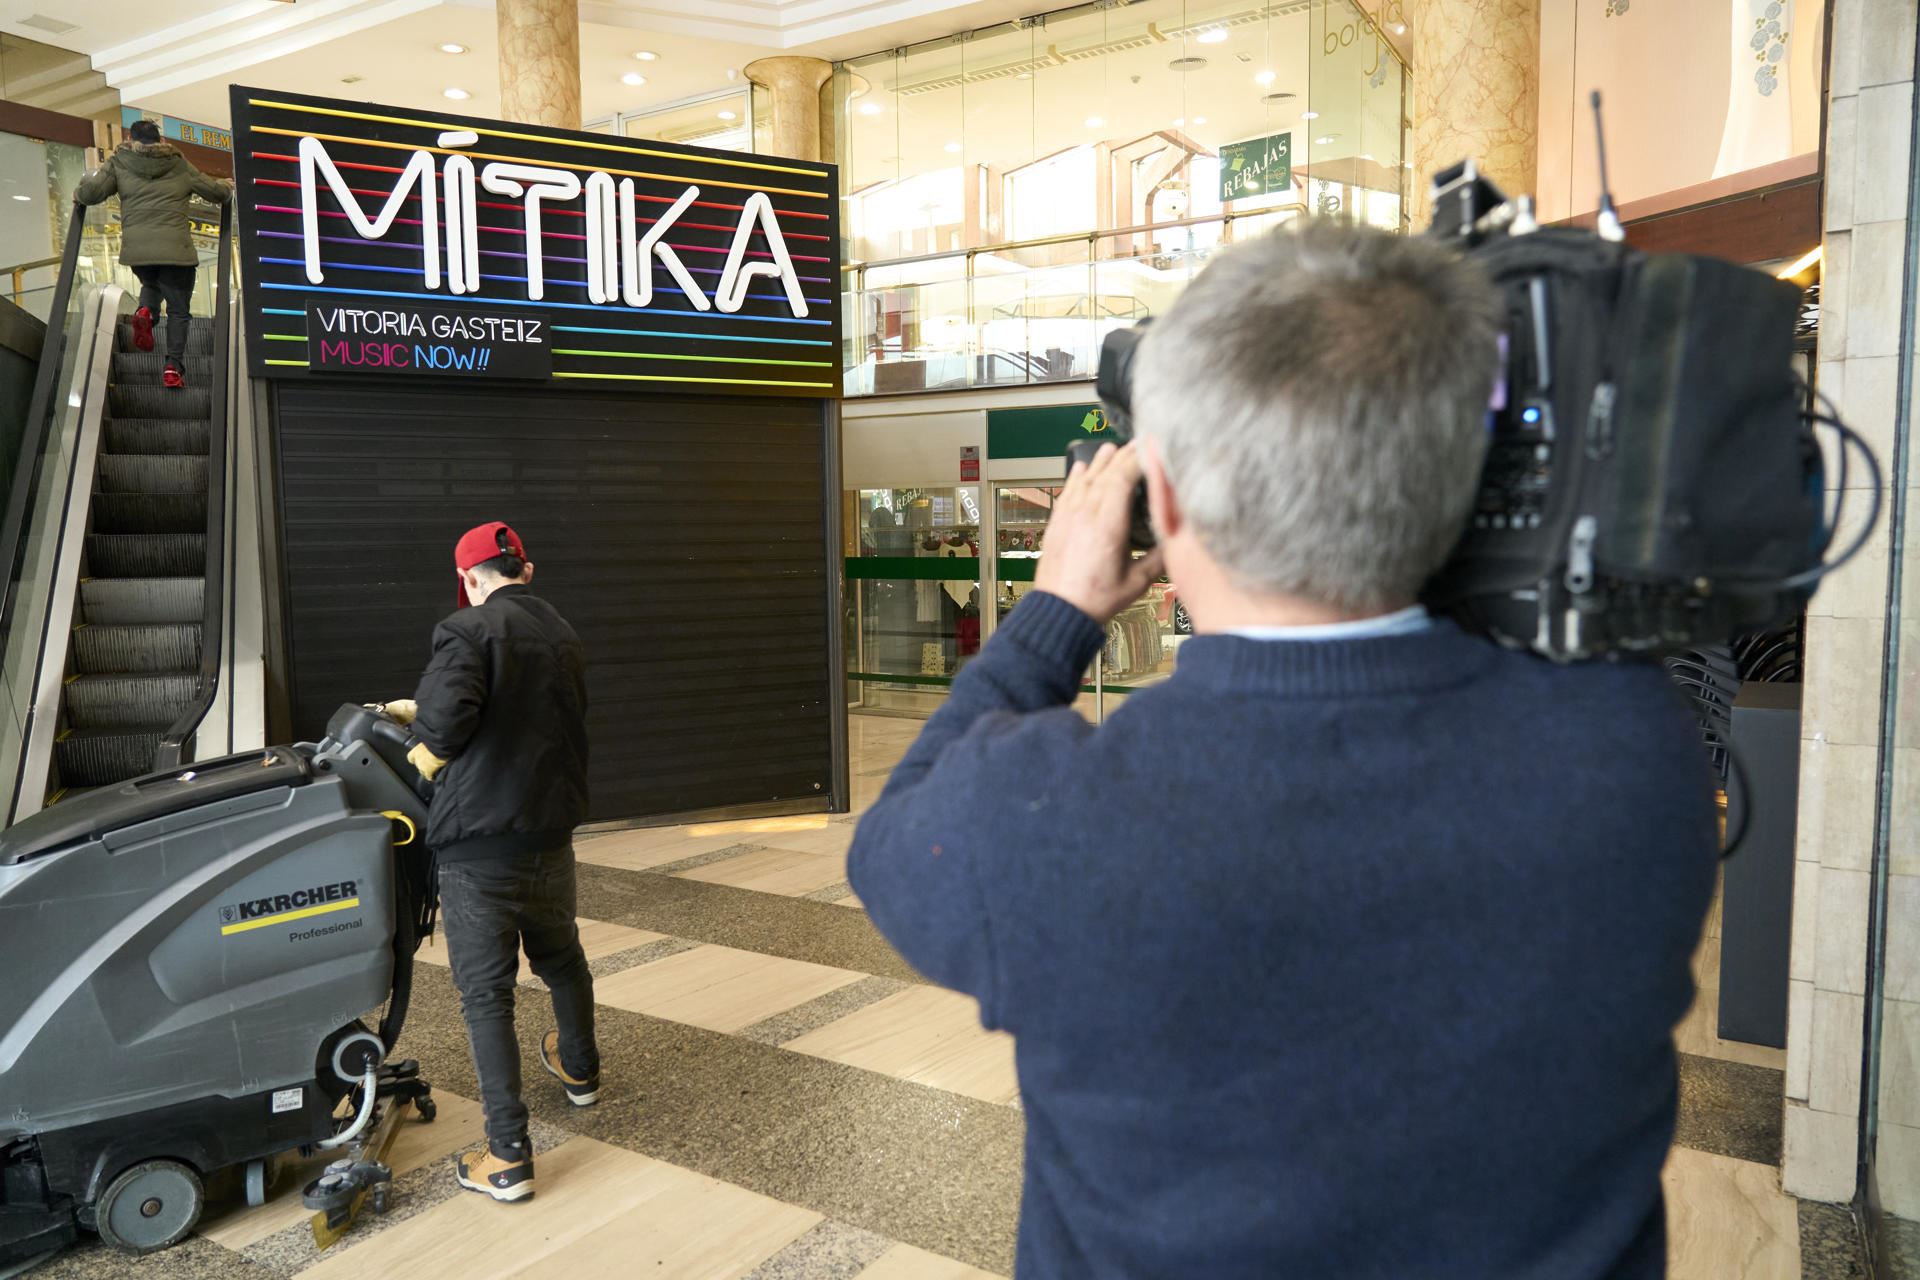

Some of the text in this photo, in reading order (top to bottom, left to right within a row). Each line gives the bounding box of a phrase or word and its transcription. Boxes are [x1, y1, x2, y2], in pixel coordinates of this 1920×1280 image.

[181, 124, 198, 142] EL
[1224, 140, 1287, 197] REBAJAS
[299, 131, 809, 318] MÍTIKA
[316, 308, 543, 343] VITORIA GASTEIZ
[320, 339, 491, 371] MUSIC NOW!!
[239, 880, 358, 920] KÄRCHER
[289, 918, 363, 943] Professional
